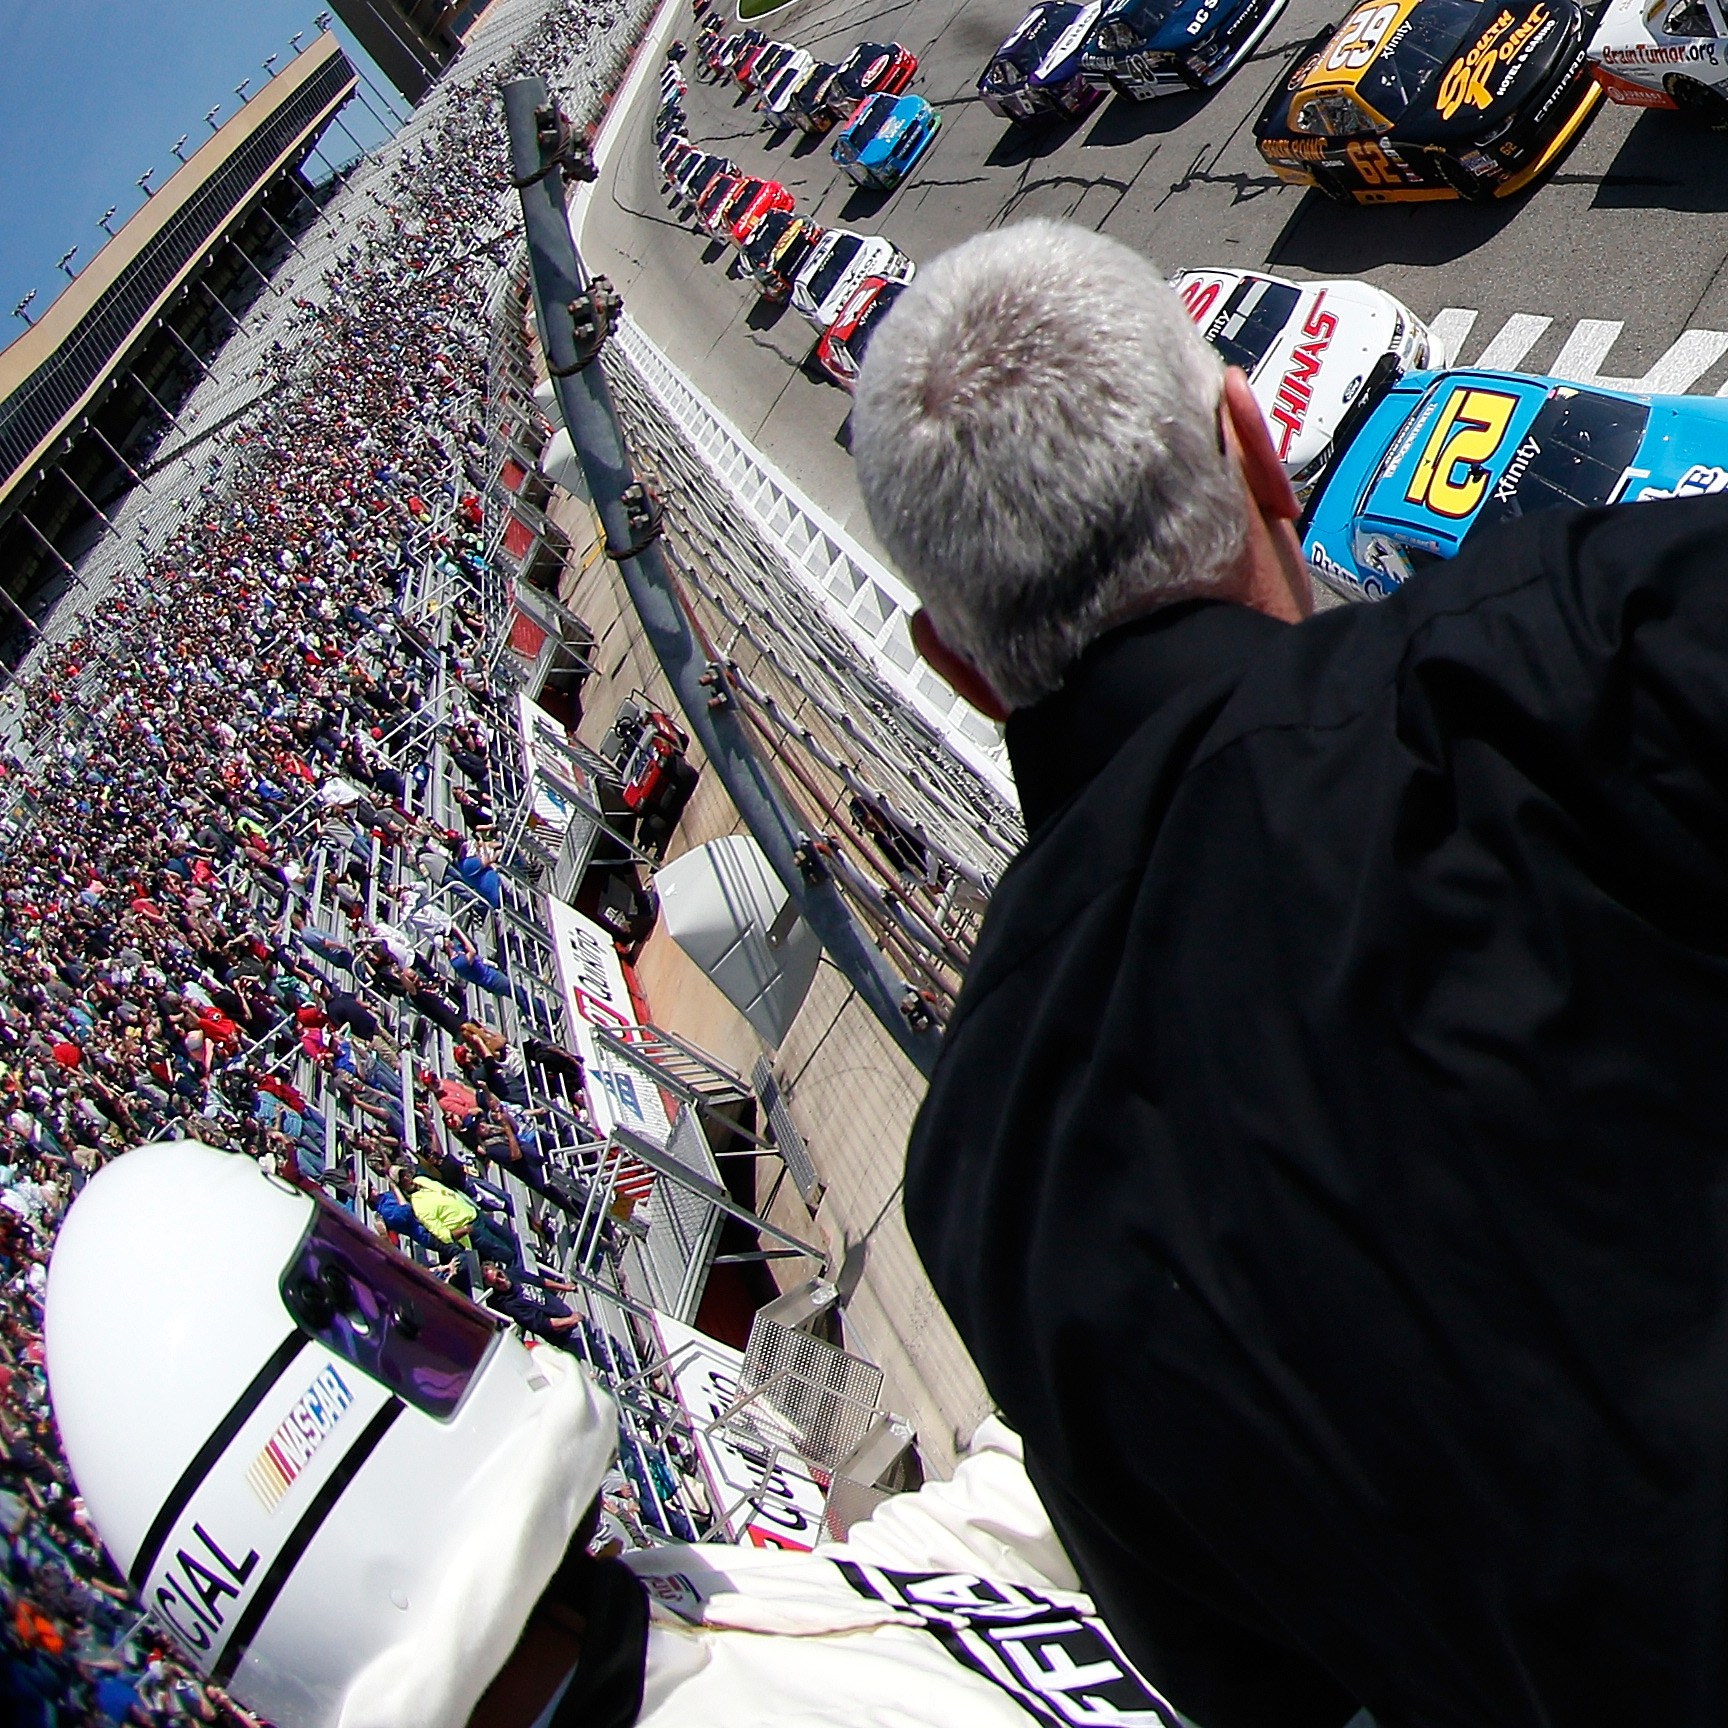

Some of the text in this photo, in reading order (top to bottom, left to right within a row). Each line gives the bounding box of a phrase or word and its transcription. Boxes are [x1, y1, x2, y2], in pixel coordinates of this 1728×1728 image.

[1186, 8, 1209, 36] DC
[1436, 7, 1517, 121] SOUTH
[1464, 2, 1551, 111] POINT
[1602, 42, 1717, 65] BrainTumor.org
[1347, 140, 1402, 185] 62
[1206, 309, 1230, 342] inity
[1494, 434, 1542, 503] xfinity
[279, 1363, 354, 1472] NASCAR
